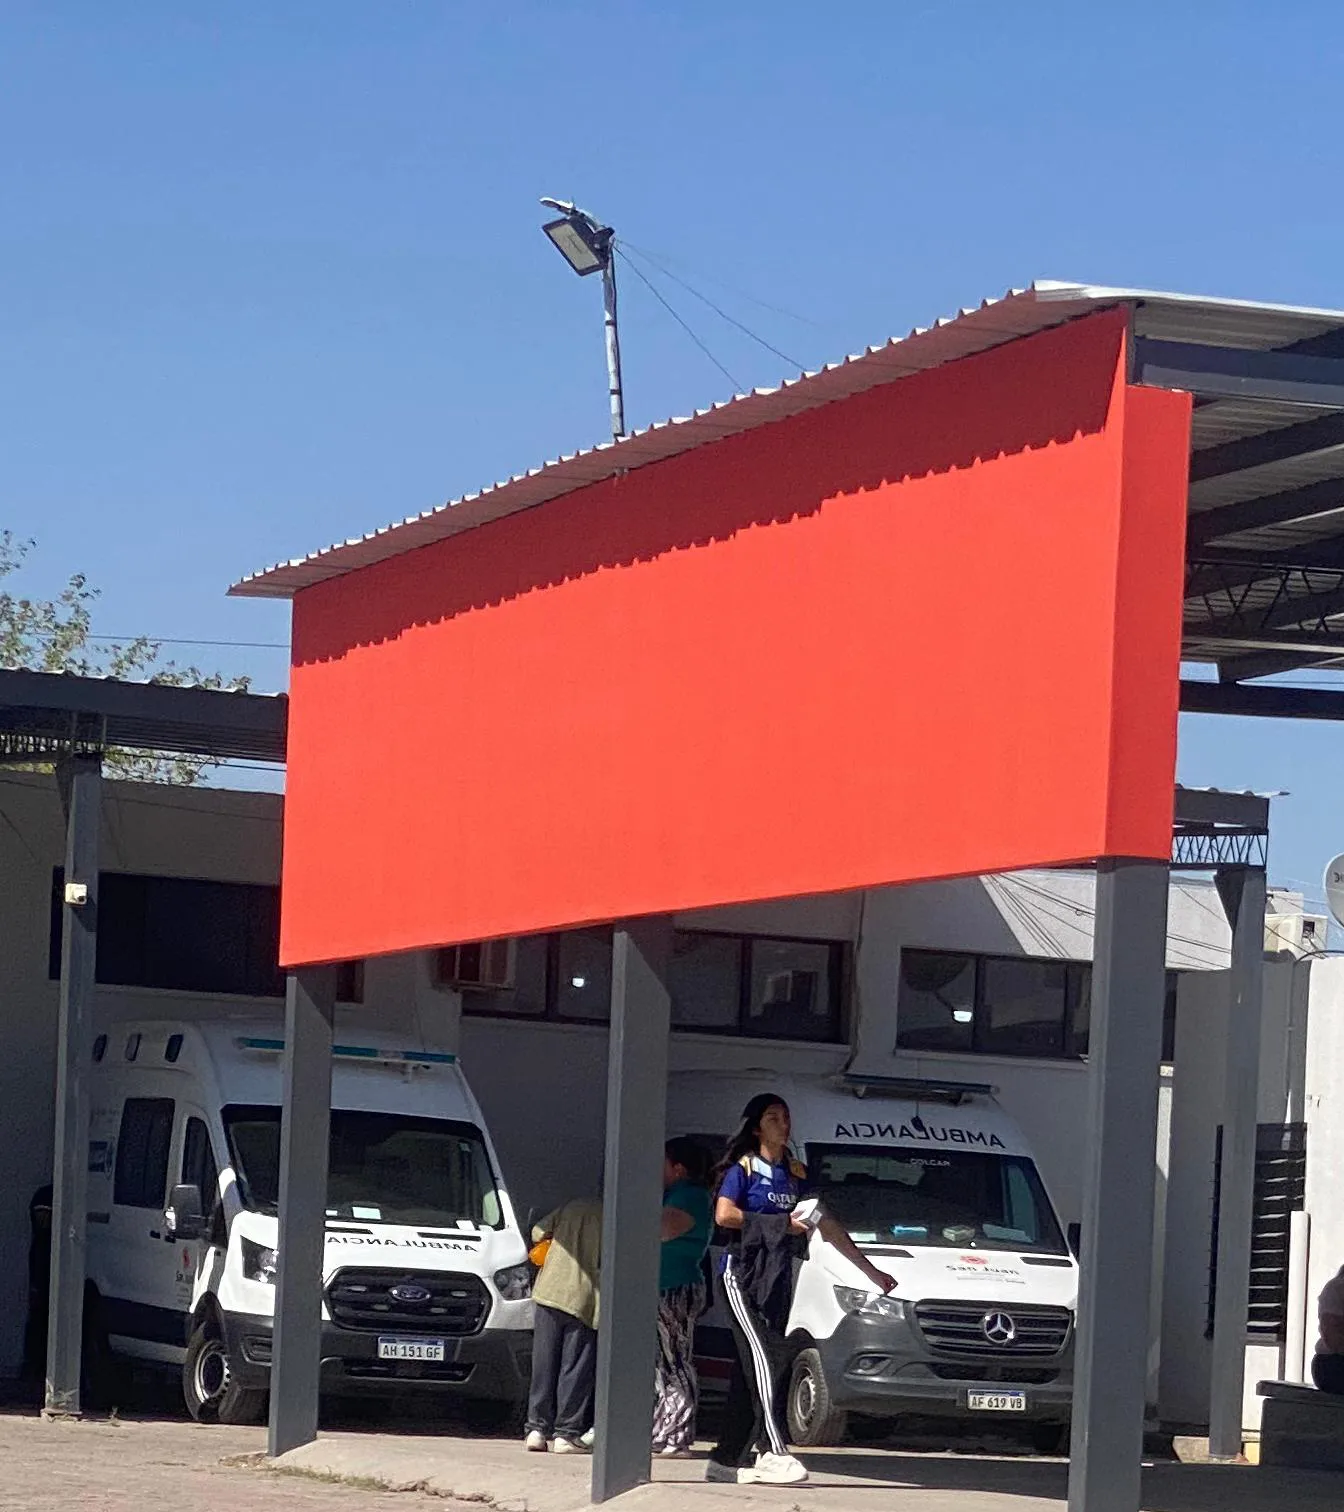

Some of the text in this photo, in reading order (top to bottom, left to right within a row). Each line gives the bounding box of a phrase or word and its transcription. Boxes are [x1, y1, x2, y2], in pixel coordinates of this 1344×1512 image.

[382, 1344, 441, 1358] AH 151 GF
[972, 1396, 1022, 1409] AF 619 VB
